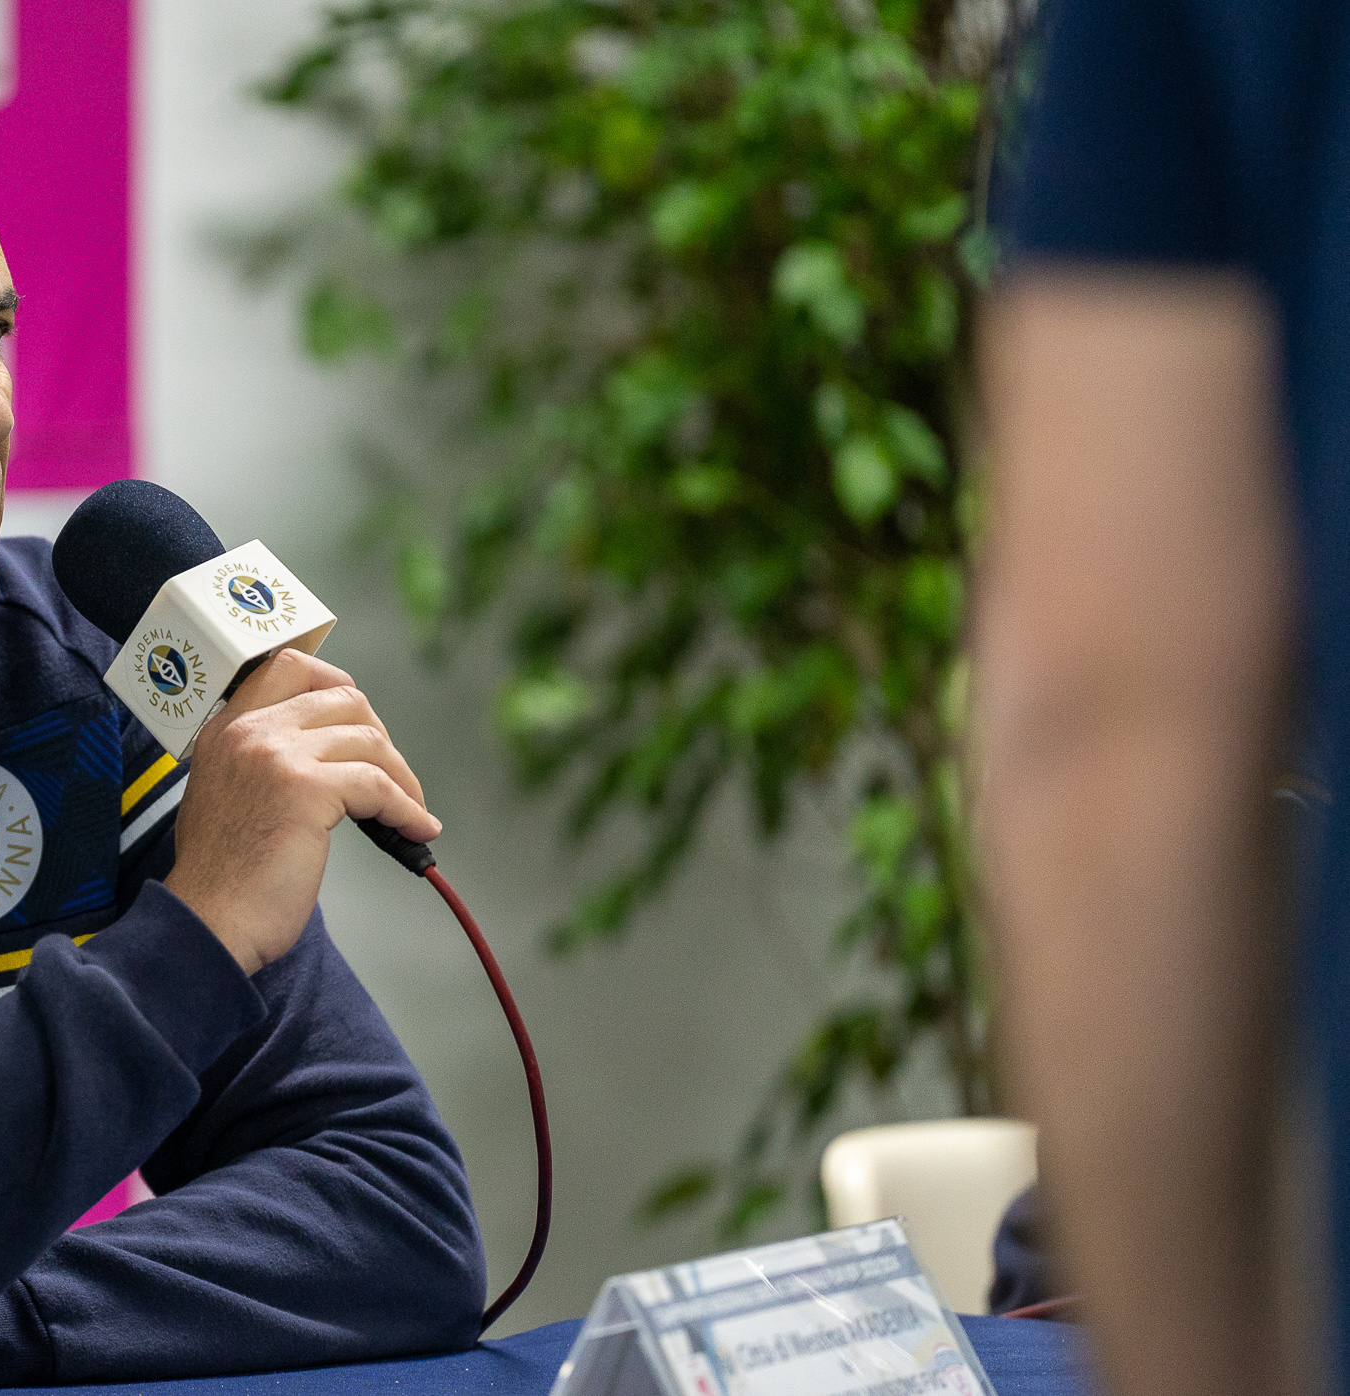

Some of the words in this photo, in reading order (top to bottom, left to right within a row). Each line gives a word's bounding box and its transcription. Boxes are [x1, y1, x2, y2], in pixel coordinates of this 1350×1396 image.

[212, 562, 260, 599] AKADEMIA
[227, 578, 298, 633] SANT'ANNA
[134, 627, 173, 684] AKADEMIA
[148, 639, 207, 718] SANT'ANNA
